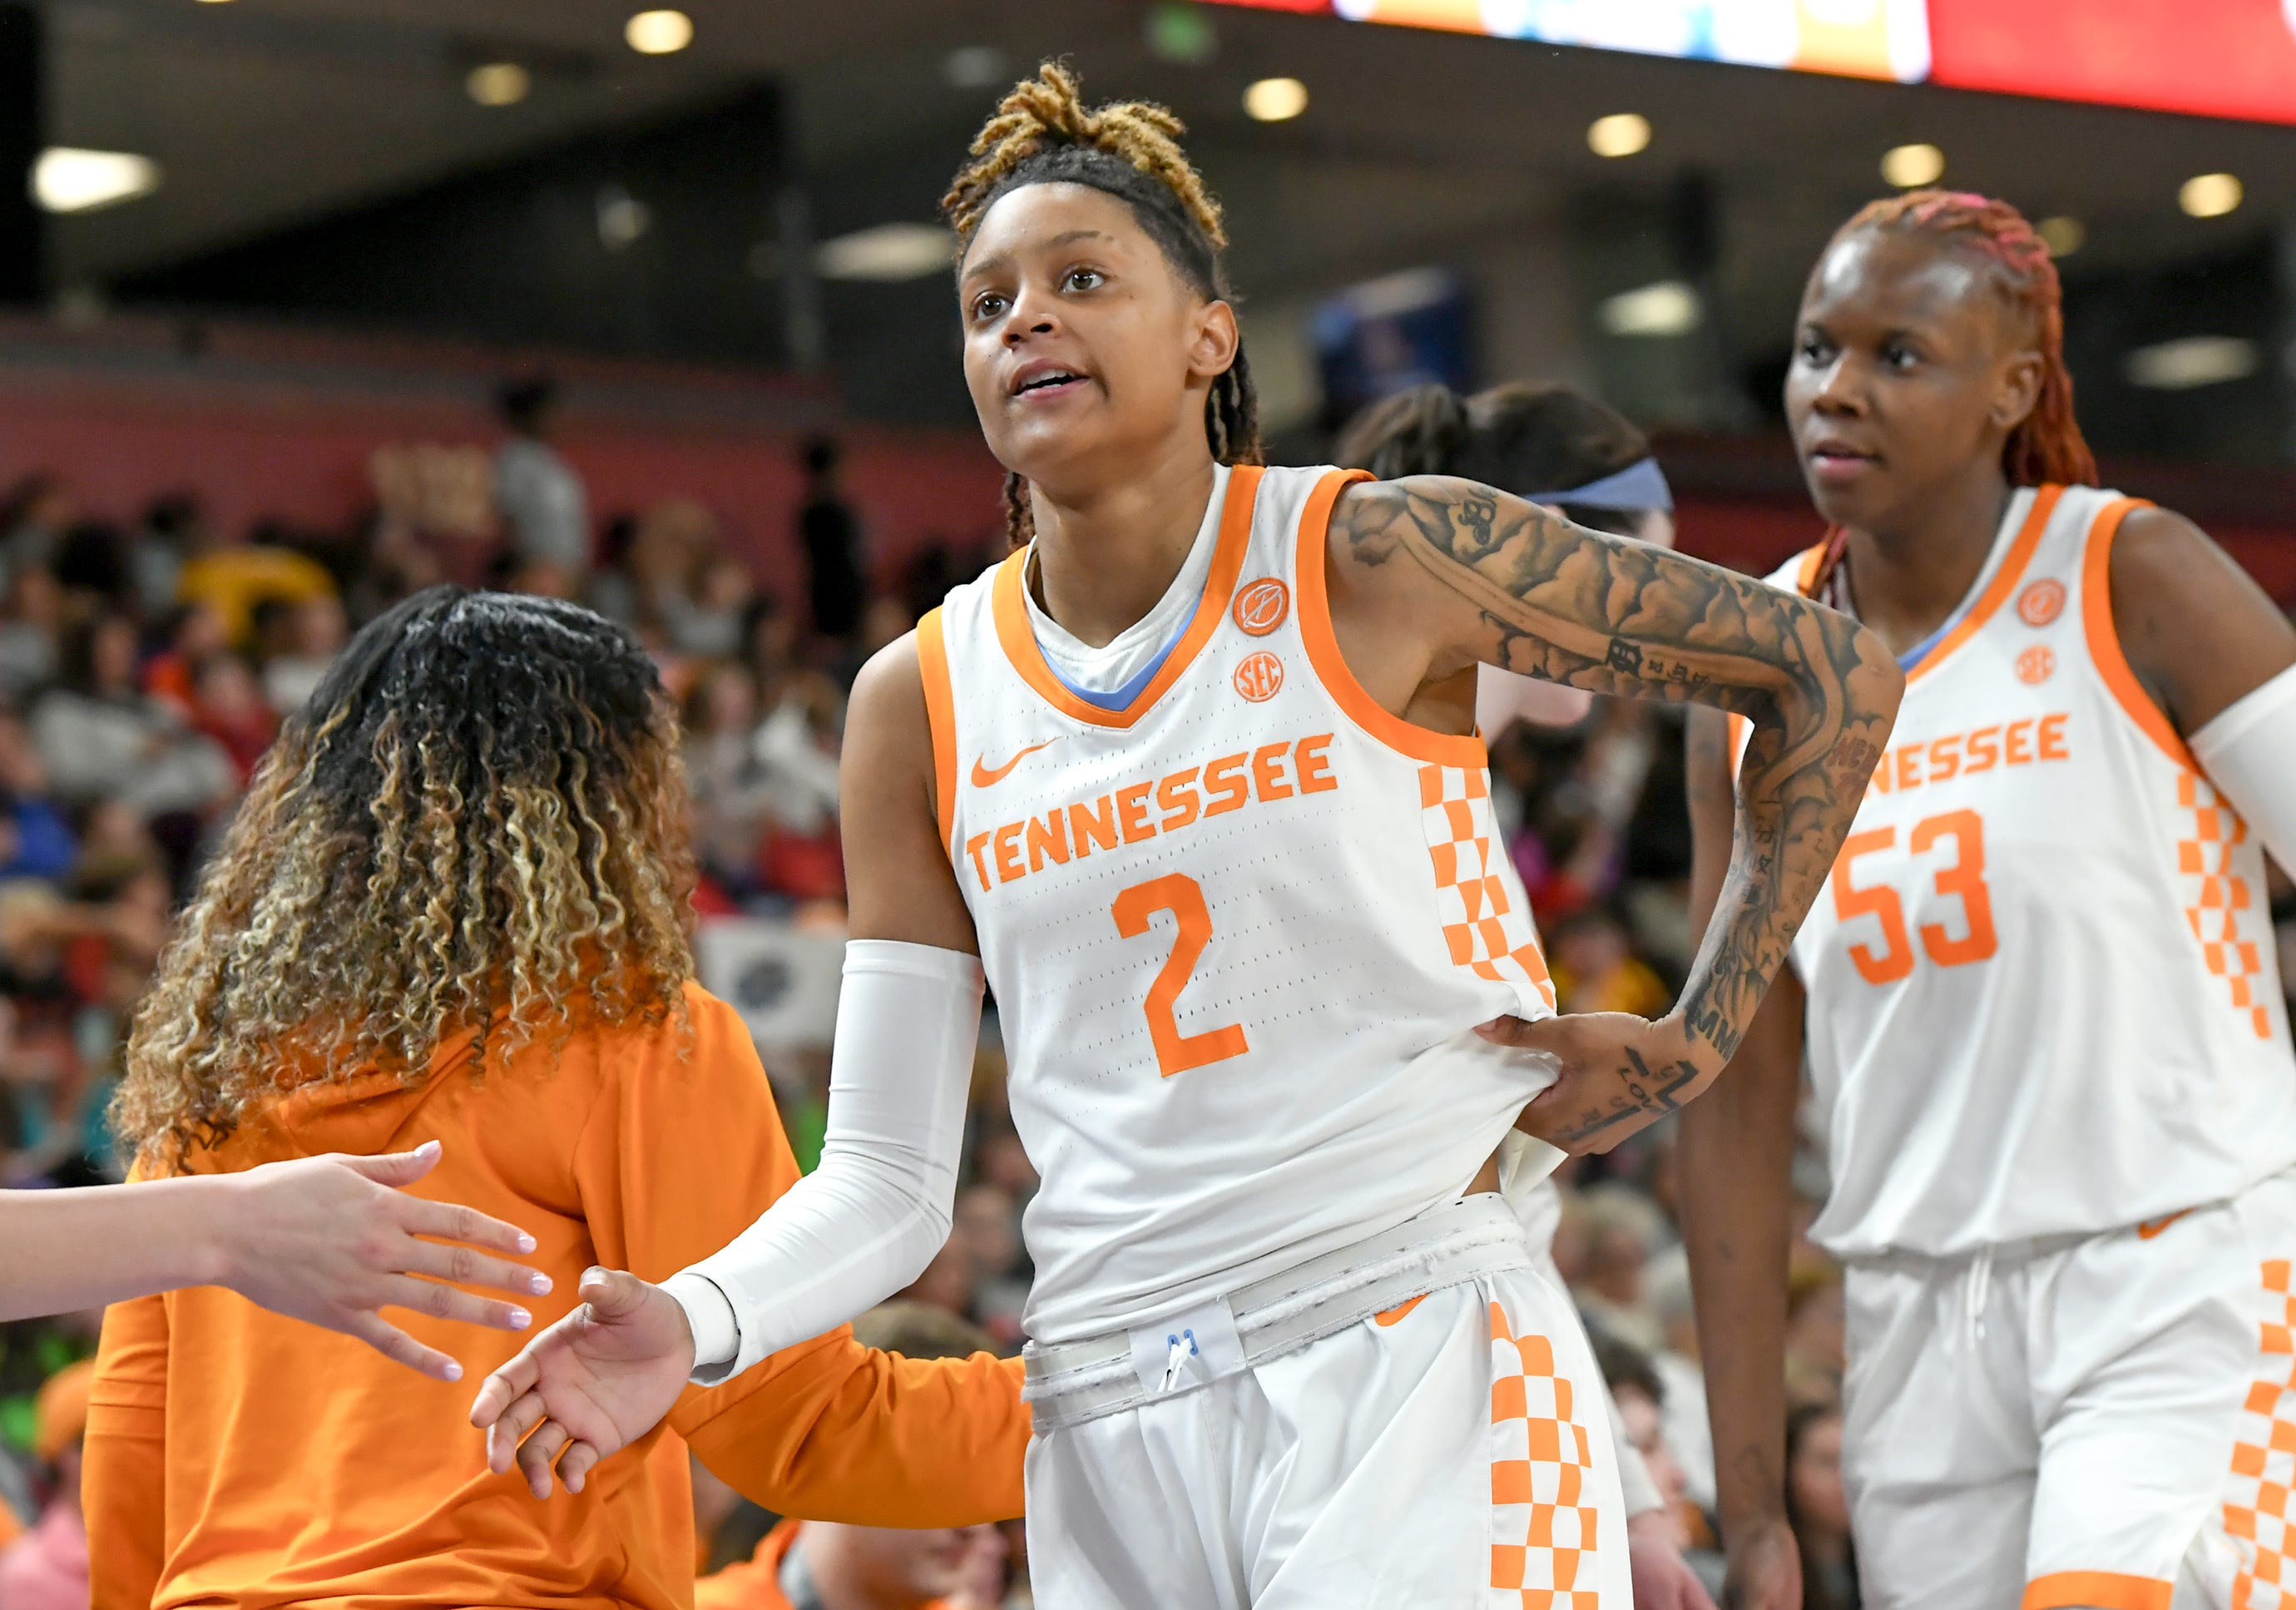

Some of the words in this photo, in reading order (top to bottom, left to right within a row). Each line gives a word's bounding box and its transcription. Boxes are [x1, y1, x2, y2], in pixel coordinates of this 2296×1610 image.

[1236, 653, 1282, 700] SEC
[1863, 713, 2070, 799] NESSEE
[966, 732, 1339, 893] TENNESSEE
[1111, 872, 1249, 1079] 2
[1832, 808, 1999, 986] 53
